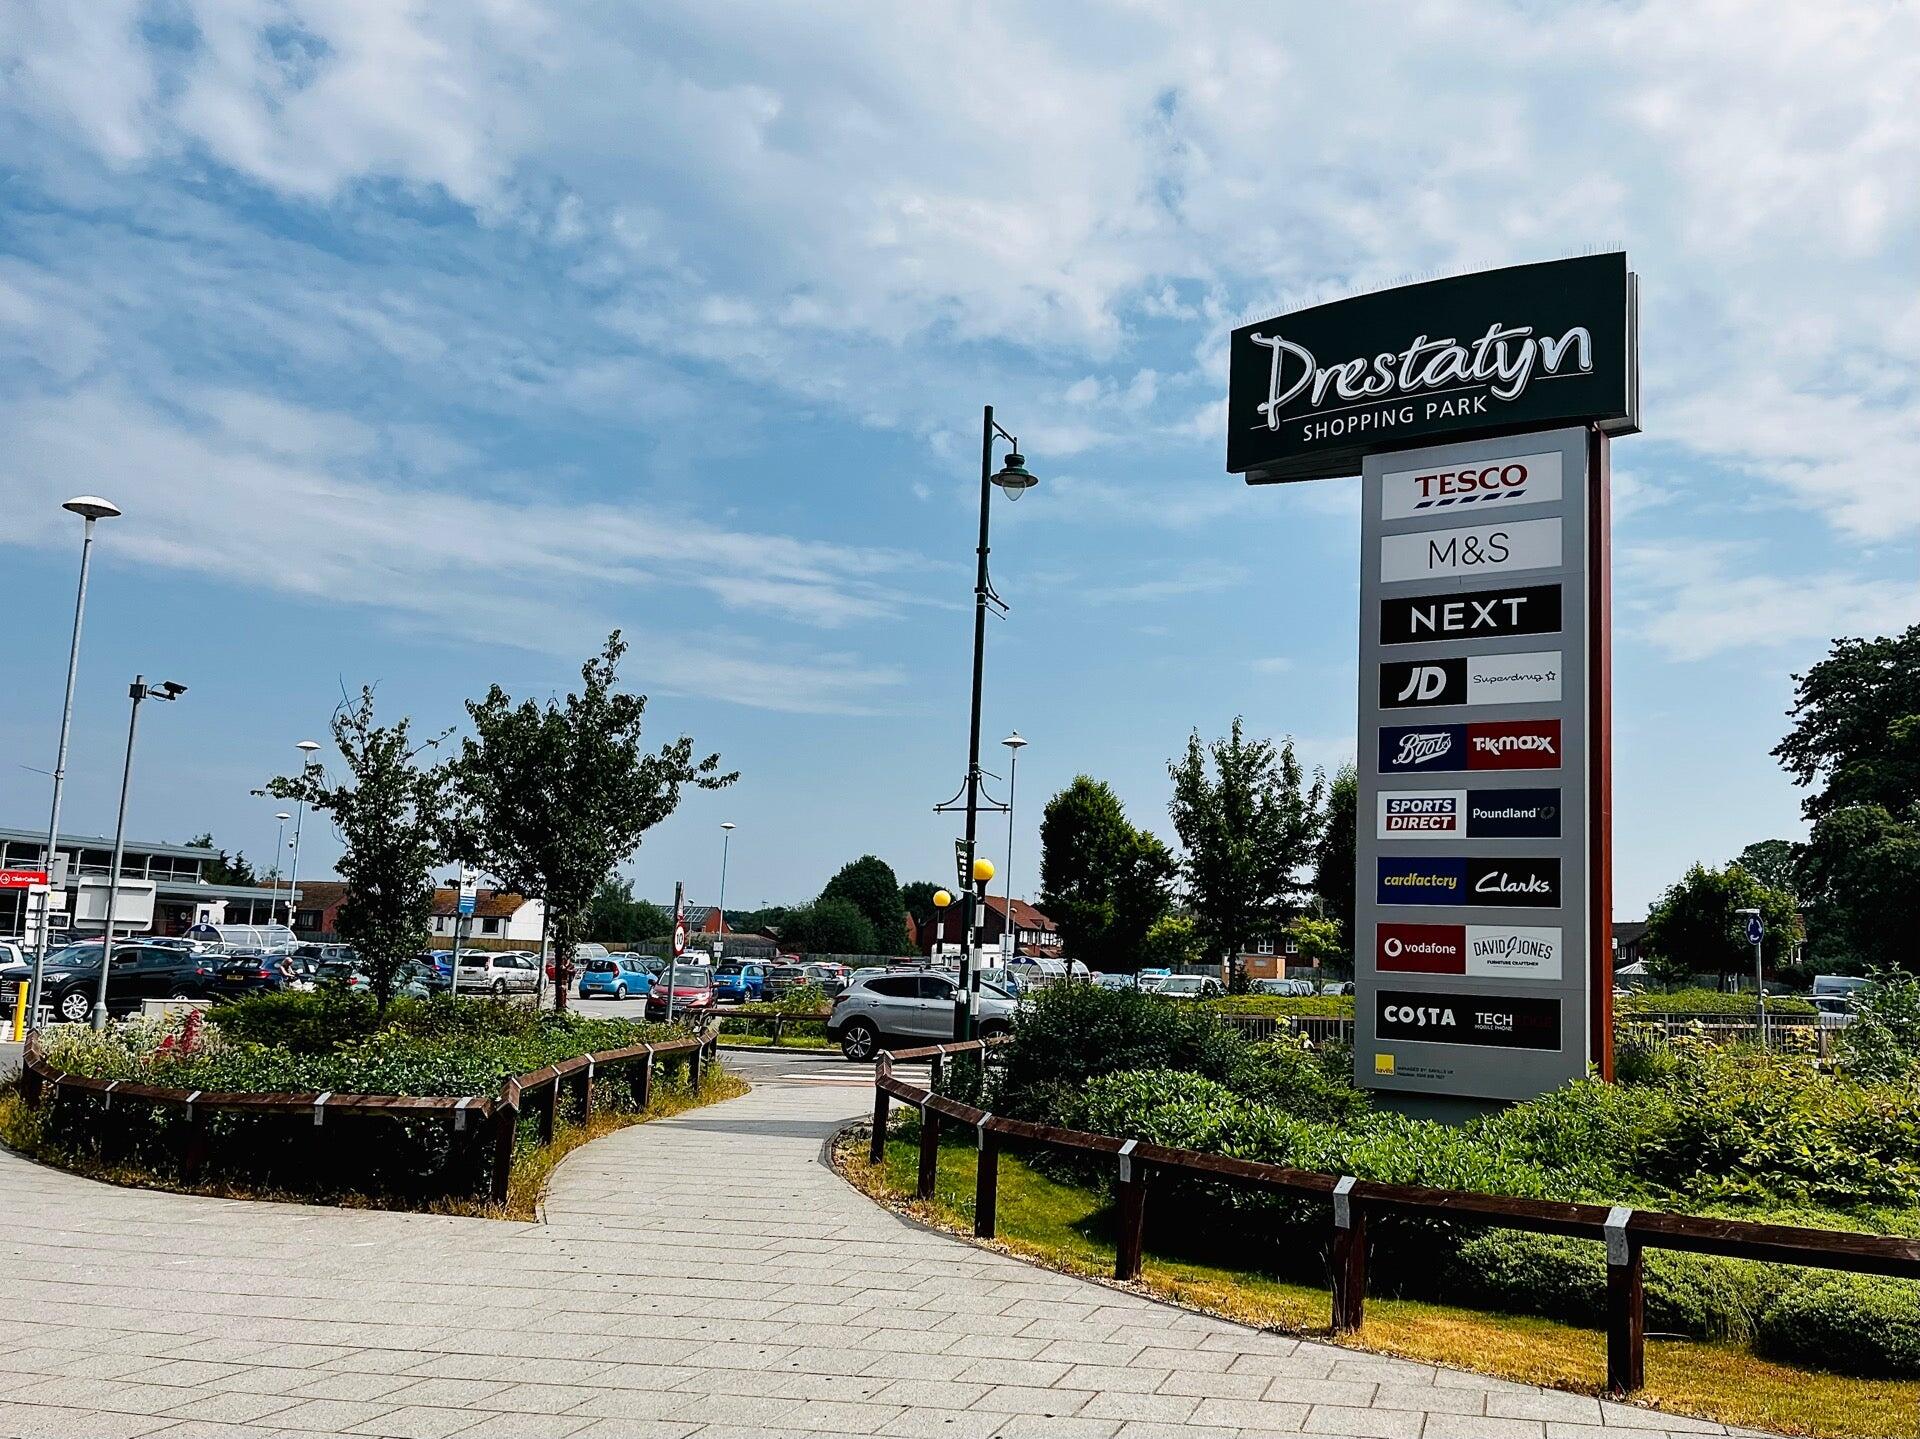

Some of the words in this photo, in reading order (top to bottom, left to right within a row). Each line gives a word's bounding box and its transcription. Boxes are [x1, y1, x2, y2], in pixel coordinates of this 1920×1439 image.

[1249, 322, 1594, 431] Prestatyn
[1303, 407, 1414, 442] SHOPPING
[1426, 395, 1488, 420] PARK
[1414, 464, 1528, 497] TESCO
[1429, 532, 1510, 569] M&S
[1411, 597, 1527, 633] NEXT
[1398, 666, 1447, 701] JD
[1473, 673, 1544, 684] Superdrug
[1392, 732, 1452, 765] Boots
[1390, 800, 1452, 813] SPORTS
[1473, 807, 1537, 819] Poundland
[1390, 816, 1451, 830] DIRECT
[1384, 873, 1457, 889] cardfactory
[1475, 871, 1550, 893] Clarks
[1405, 942, 1456, 954] vodafone
[1474, 939, 1505, 957] DAVID
[1517, 940, 1553, 960] JONES
[1384, 1005, 1456, 1026] COSTA
[1475, 1012, 1513, 1026] TECH
